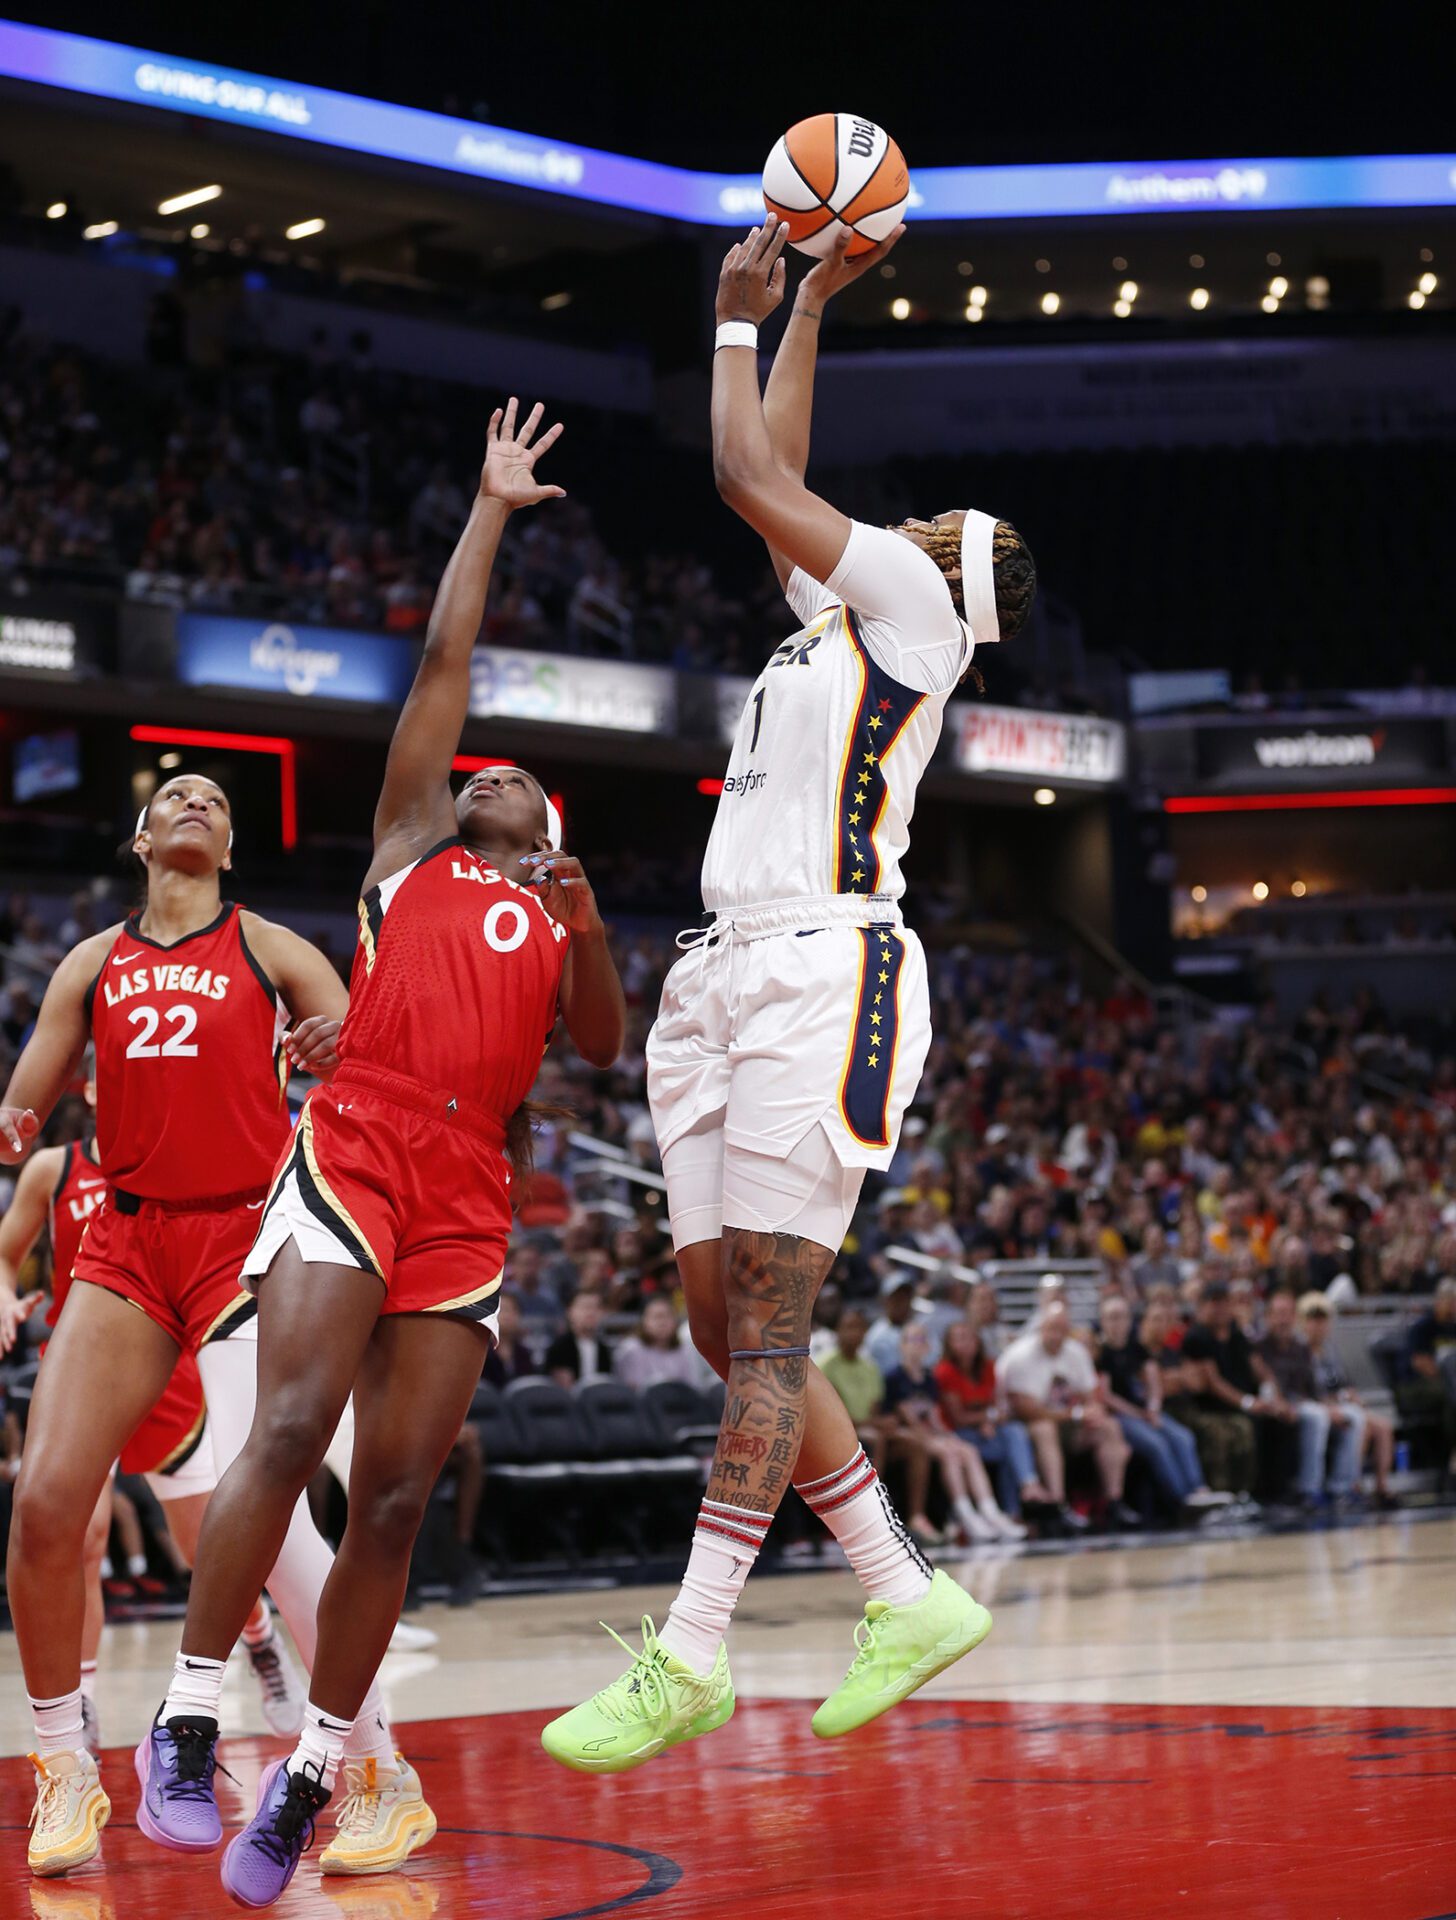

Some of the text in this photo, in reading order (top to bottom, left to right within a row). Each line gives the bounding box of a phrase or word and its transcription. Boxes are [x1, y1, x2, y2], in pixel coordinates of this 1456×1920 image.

[1105, 172, 1218, 204] Anthem
[249, 623, 342, 696] Kroger
[750, 686, 767, 755] 1
[1254, 730, 1376, 768] verizon
[451, 861, 502, 885] LAS
[483, 900, 530, 953] 0
[103, 964, 230, 1008] LAS VEGAS
[125, 1004, 198, 1059] 22
